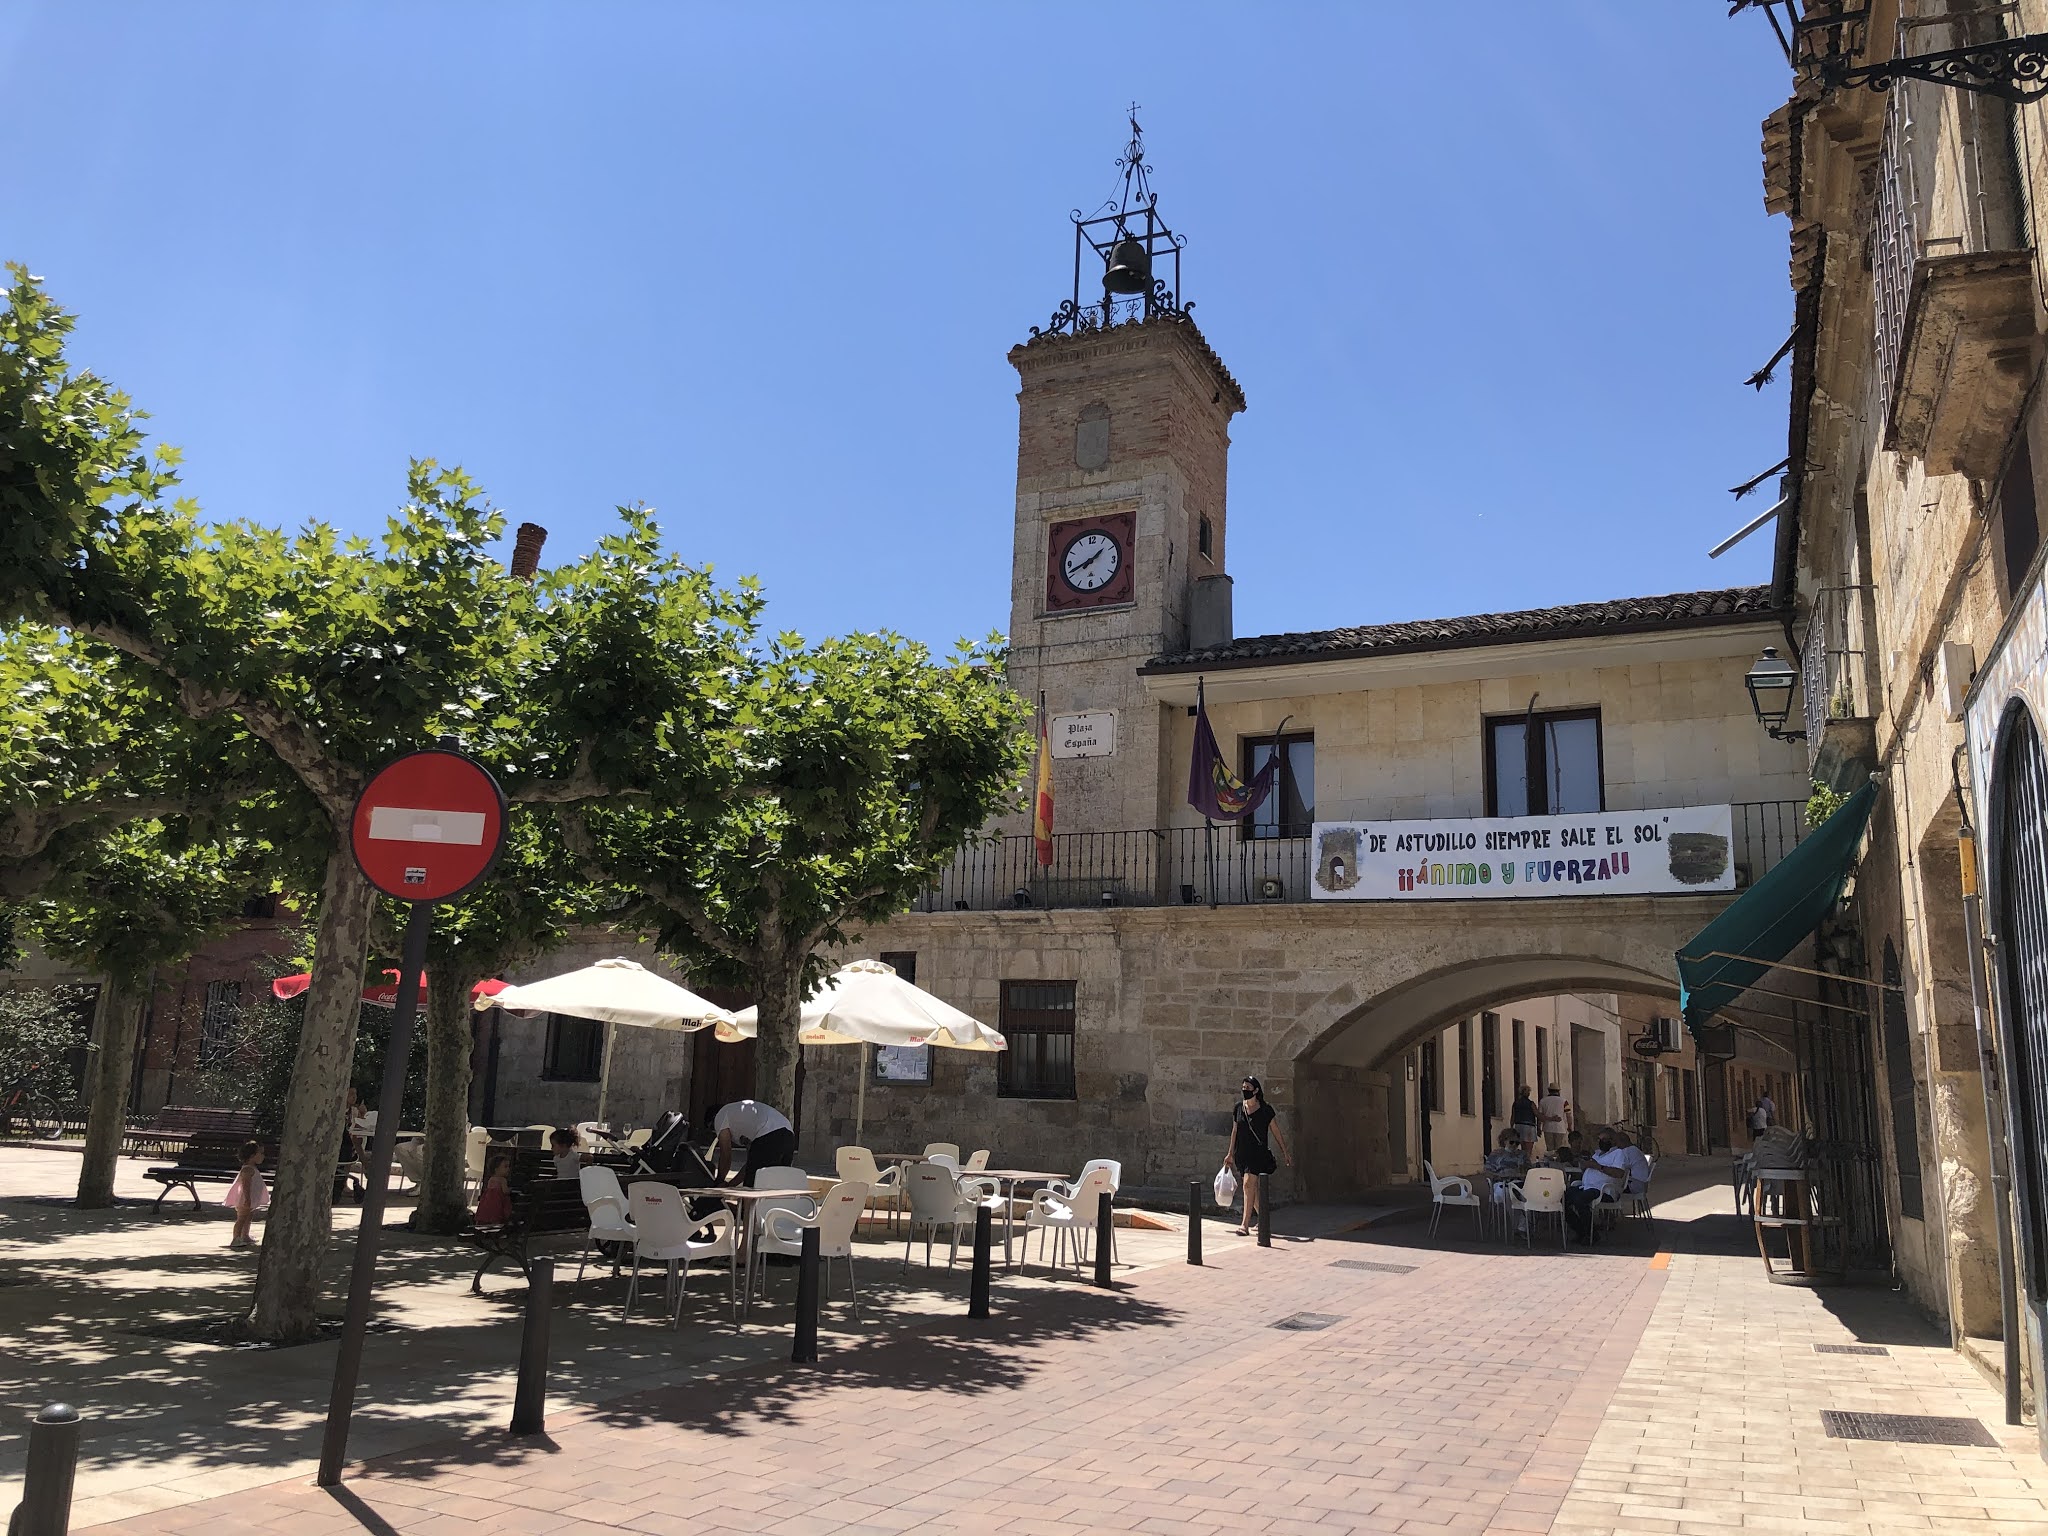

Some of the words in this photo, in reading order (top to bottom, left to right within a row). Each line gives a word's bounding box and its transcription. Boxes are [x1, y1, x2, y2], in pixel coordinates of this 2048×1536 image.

[1088, 536, 1097, 545] 12
[1067, 560, 1072, 568] 9
[1111, 556, 1116, 564] 3
[1088, 580, 1093, 588] 6
[1068, 724, 1093, 734] Plaza
[1064, 737, 1097, 748] España
[1396, 832, 1477, 852] ASTUDILLO
[1485, 829, 1551, 850] SIEMPRE
[1561, 827, 1596, 848] SALE
[1605, 826, 1623, 846] EL
[1501, 861, 1515, 885] Y
[681, 1018, 702, 1027] Mah
